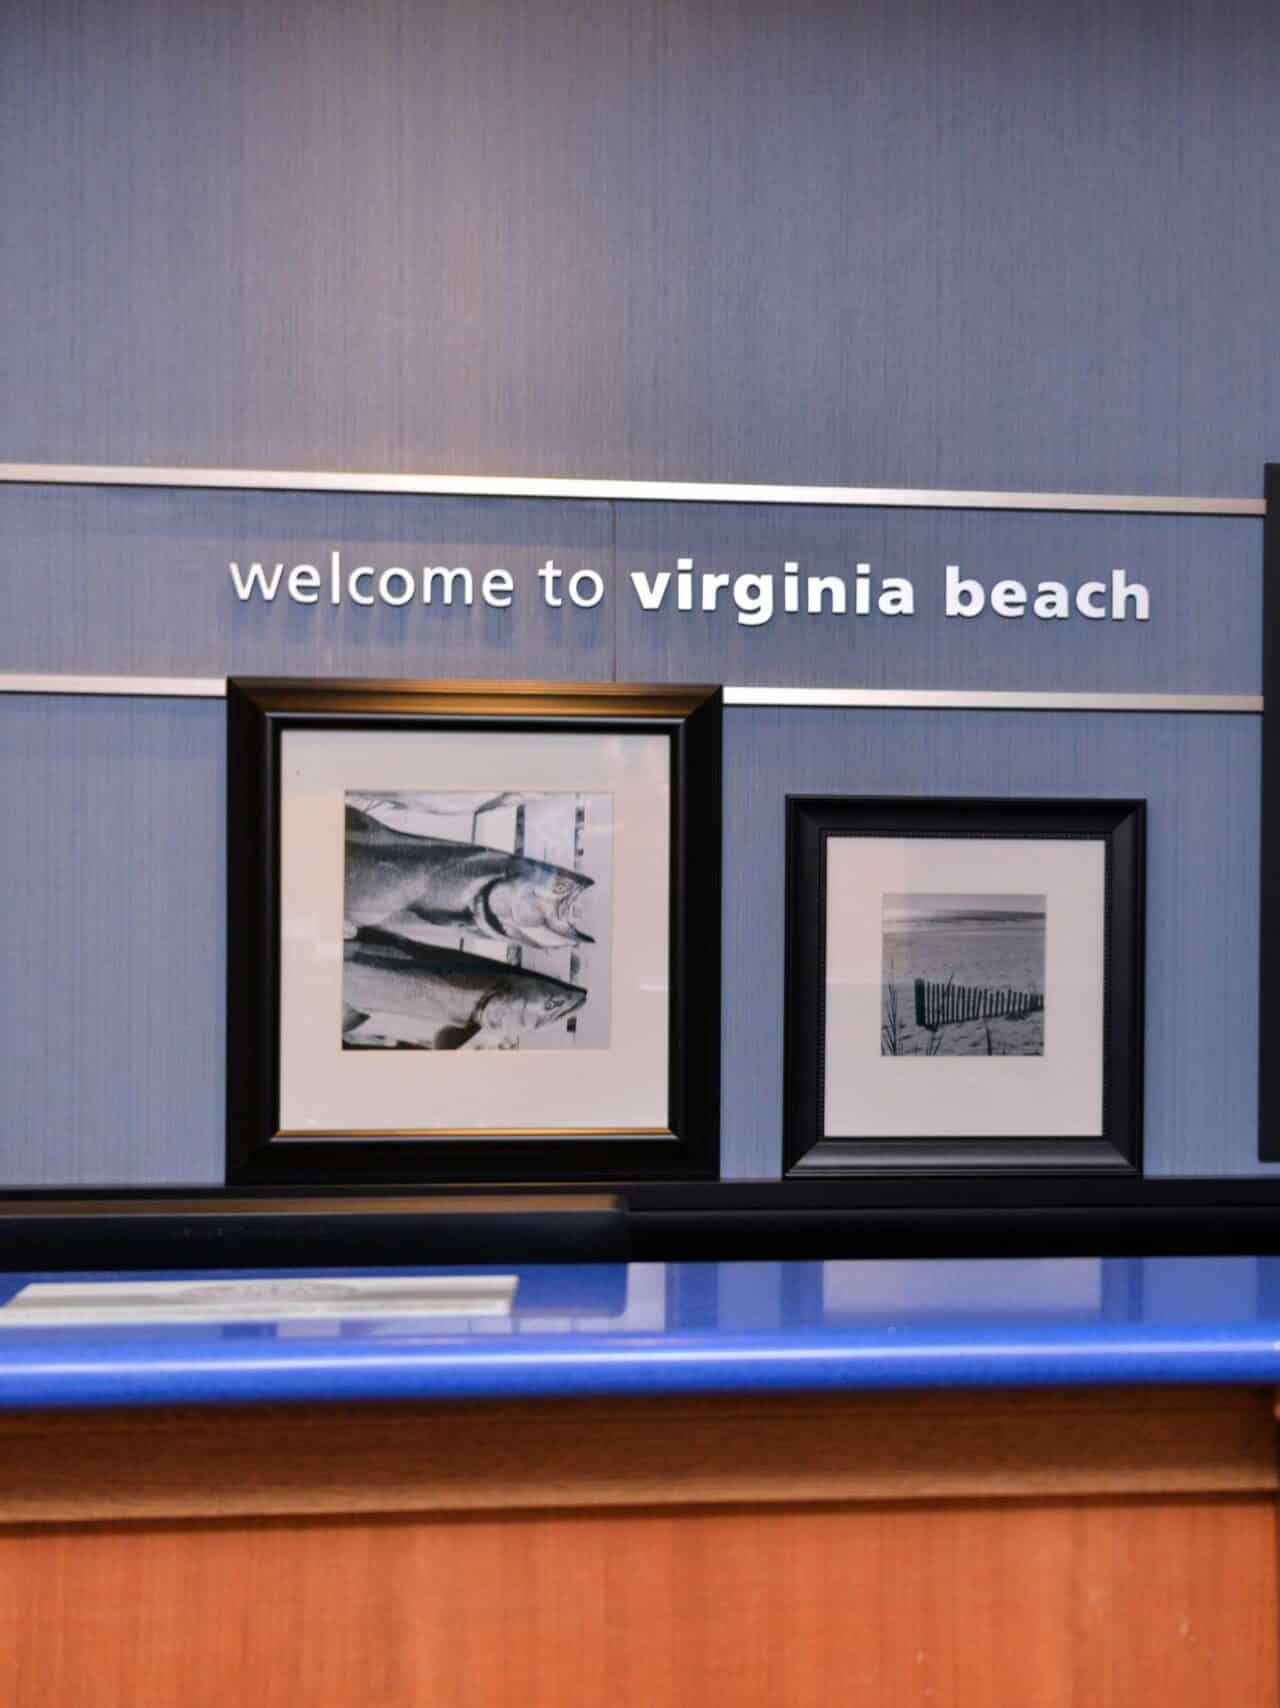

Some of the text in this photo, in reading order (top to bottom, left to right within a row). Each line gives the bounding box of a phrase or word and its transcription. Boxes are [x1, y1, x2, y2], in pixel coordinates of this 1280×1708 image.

[228, 550, 1151, 626] welcome to virginia beach
